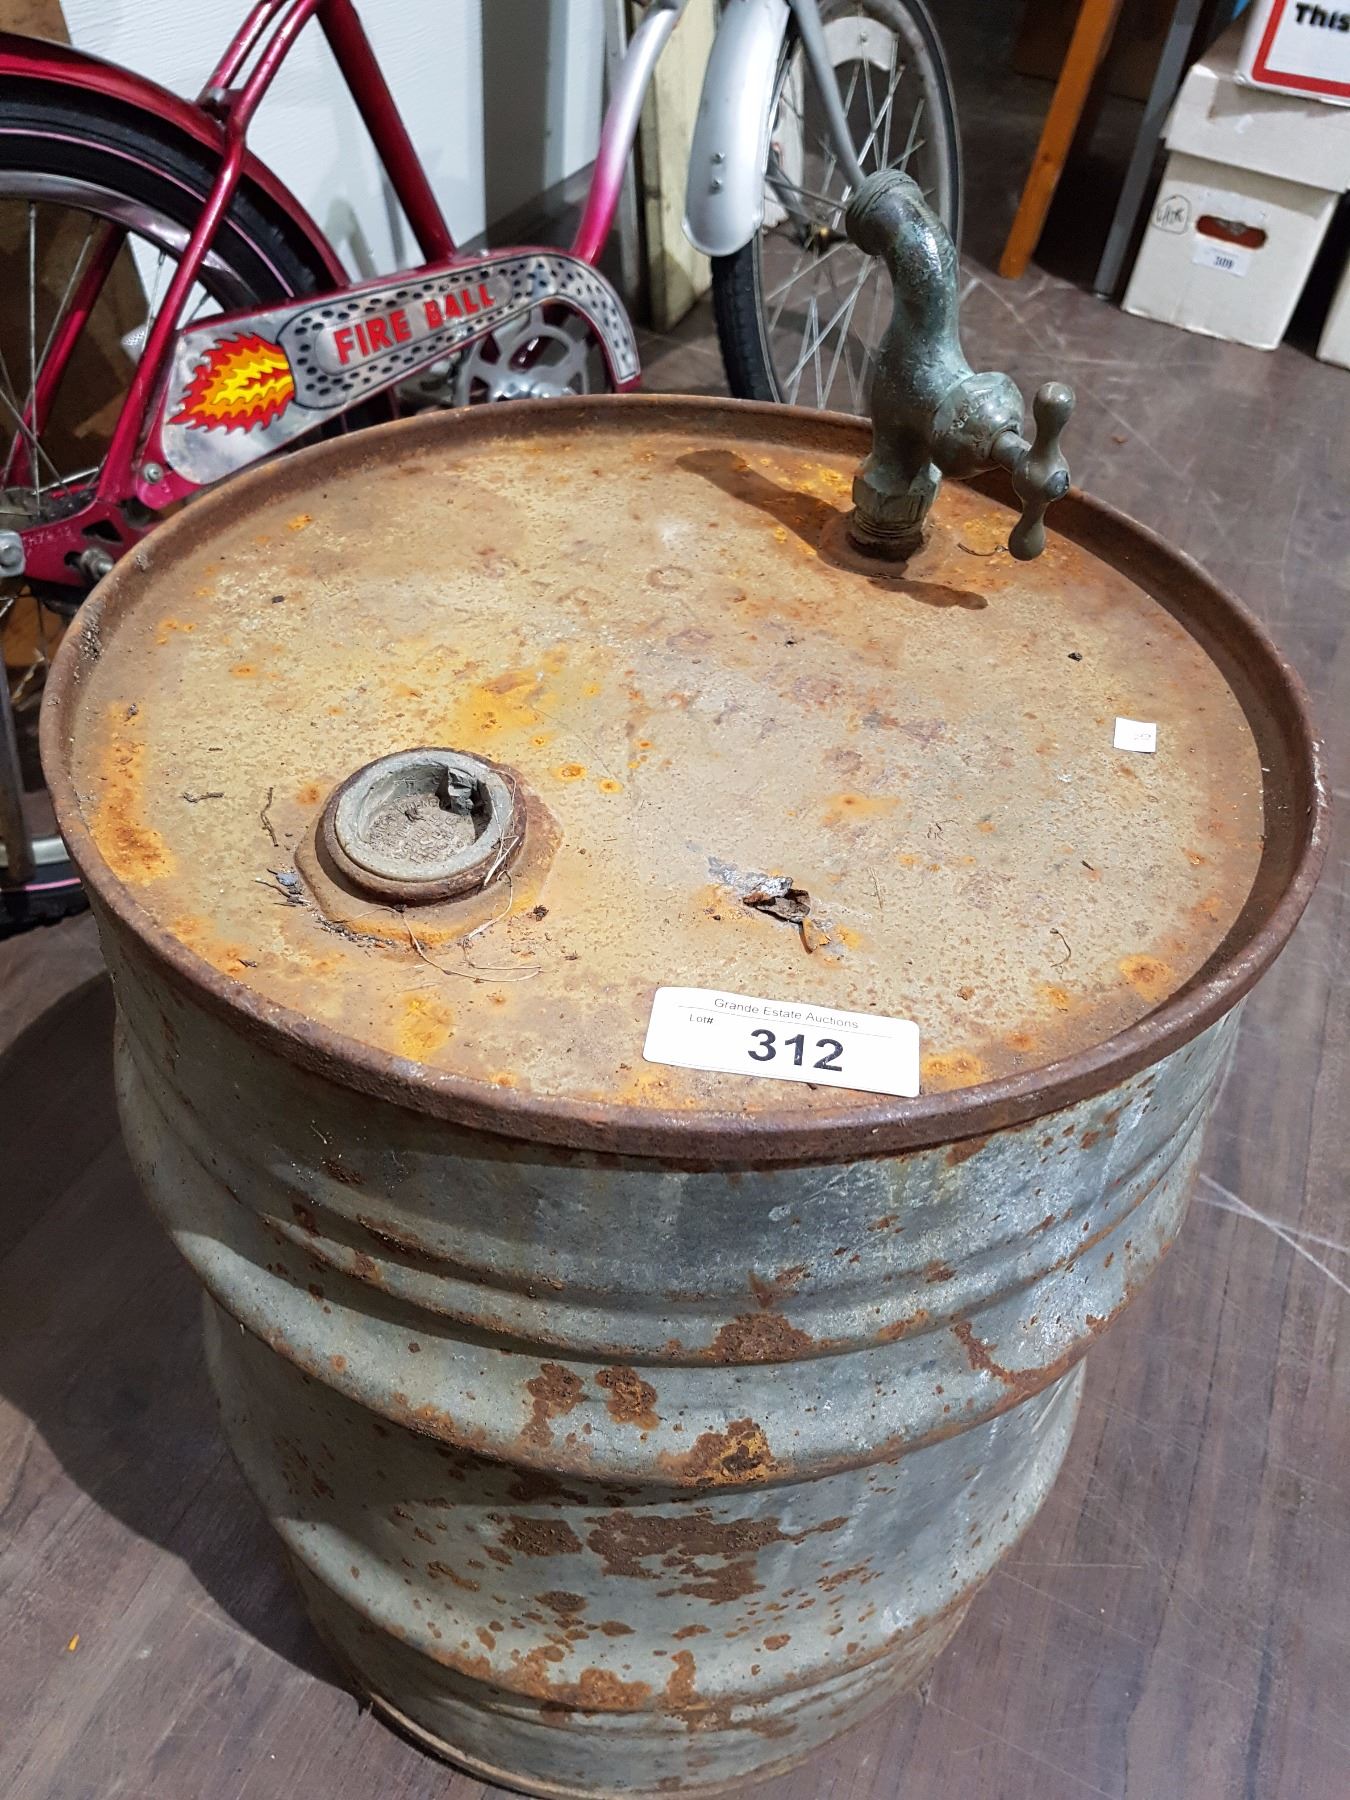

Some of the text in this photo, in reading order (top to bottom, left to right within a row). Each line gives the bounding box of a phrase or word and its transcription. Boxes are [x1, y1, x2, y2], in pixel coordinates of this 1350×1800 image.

[1295, 2, 1350, 33] This
[333, 283, 496, 365] FIRE BALL
[689, 1013, 714, 1025] Lot#
[714, 997, 859, 1029] Grande Estate Auctions
[747, 1028, 844, 1072] 312
